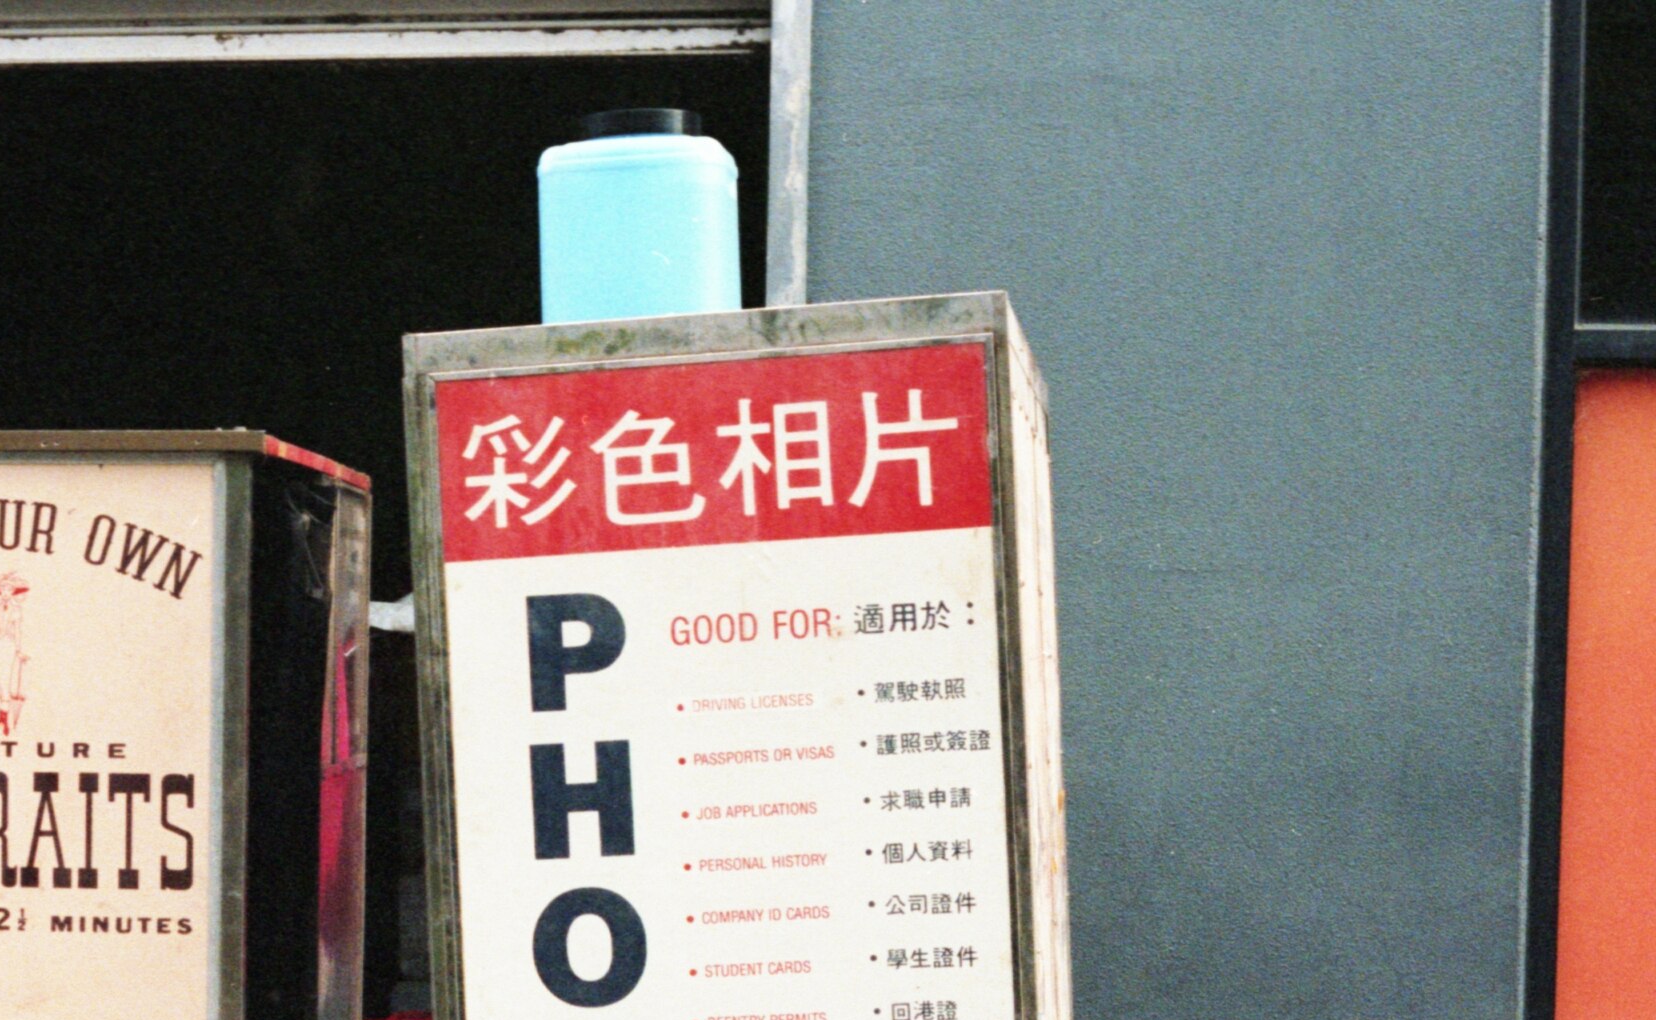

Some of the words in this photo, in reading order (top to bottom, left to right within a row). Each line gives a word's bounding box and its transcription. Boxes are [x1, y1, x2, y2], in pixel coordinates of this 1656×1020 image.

[462, 389, 958, 528] 彩色相片
[83, 514, 203, 600] OWN
[670, 612, 759, 646] GOOD
[773, 608, 843, 639] FOR:
[874, 678, 966, 703] 駕駛執照
[693, 696, 746, 713] DRIVING
[751, 693, 814, 710] LICENSES
[877, 729, 991, 755] 護照或簽證
[693, 749, 769, 767] PASSPORTS
[774, 748, 792, 764] OR
[797, 745, 834, 762] VISAS
[880, 787, 971, 811] 求職申請
[696, 805, 722, 821] JOB
[726, 801, 817, 819] APPLICATIONS
[699, 856, 766, 873] PERSONAL
[771, 853, 827, 869] HISTORY
[882, 839, 973, 864] 個人資料
[702, 908, 764, 925] COMPANY
[768, 908, 782, 922] ID
[785, 905, 830, 921] CARDS
[886, 892, 976, 915] 公司證件
[50, 914, 192, 935] MINUTES
[887, 946, 978, 969] 學生證件
[704, 963, 763, 979] STUDENT
[768, 960, 811, 976] CARDS
